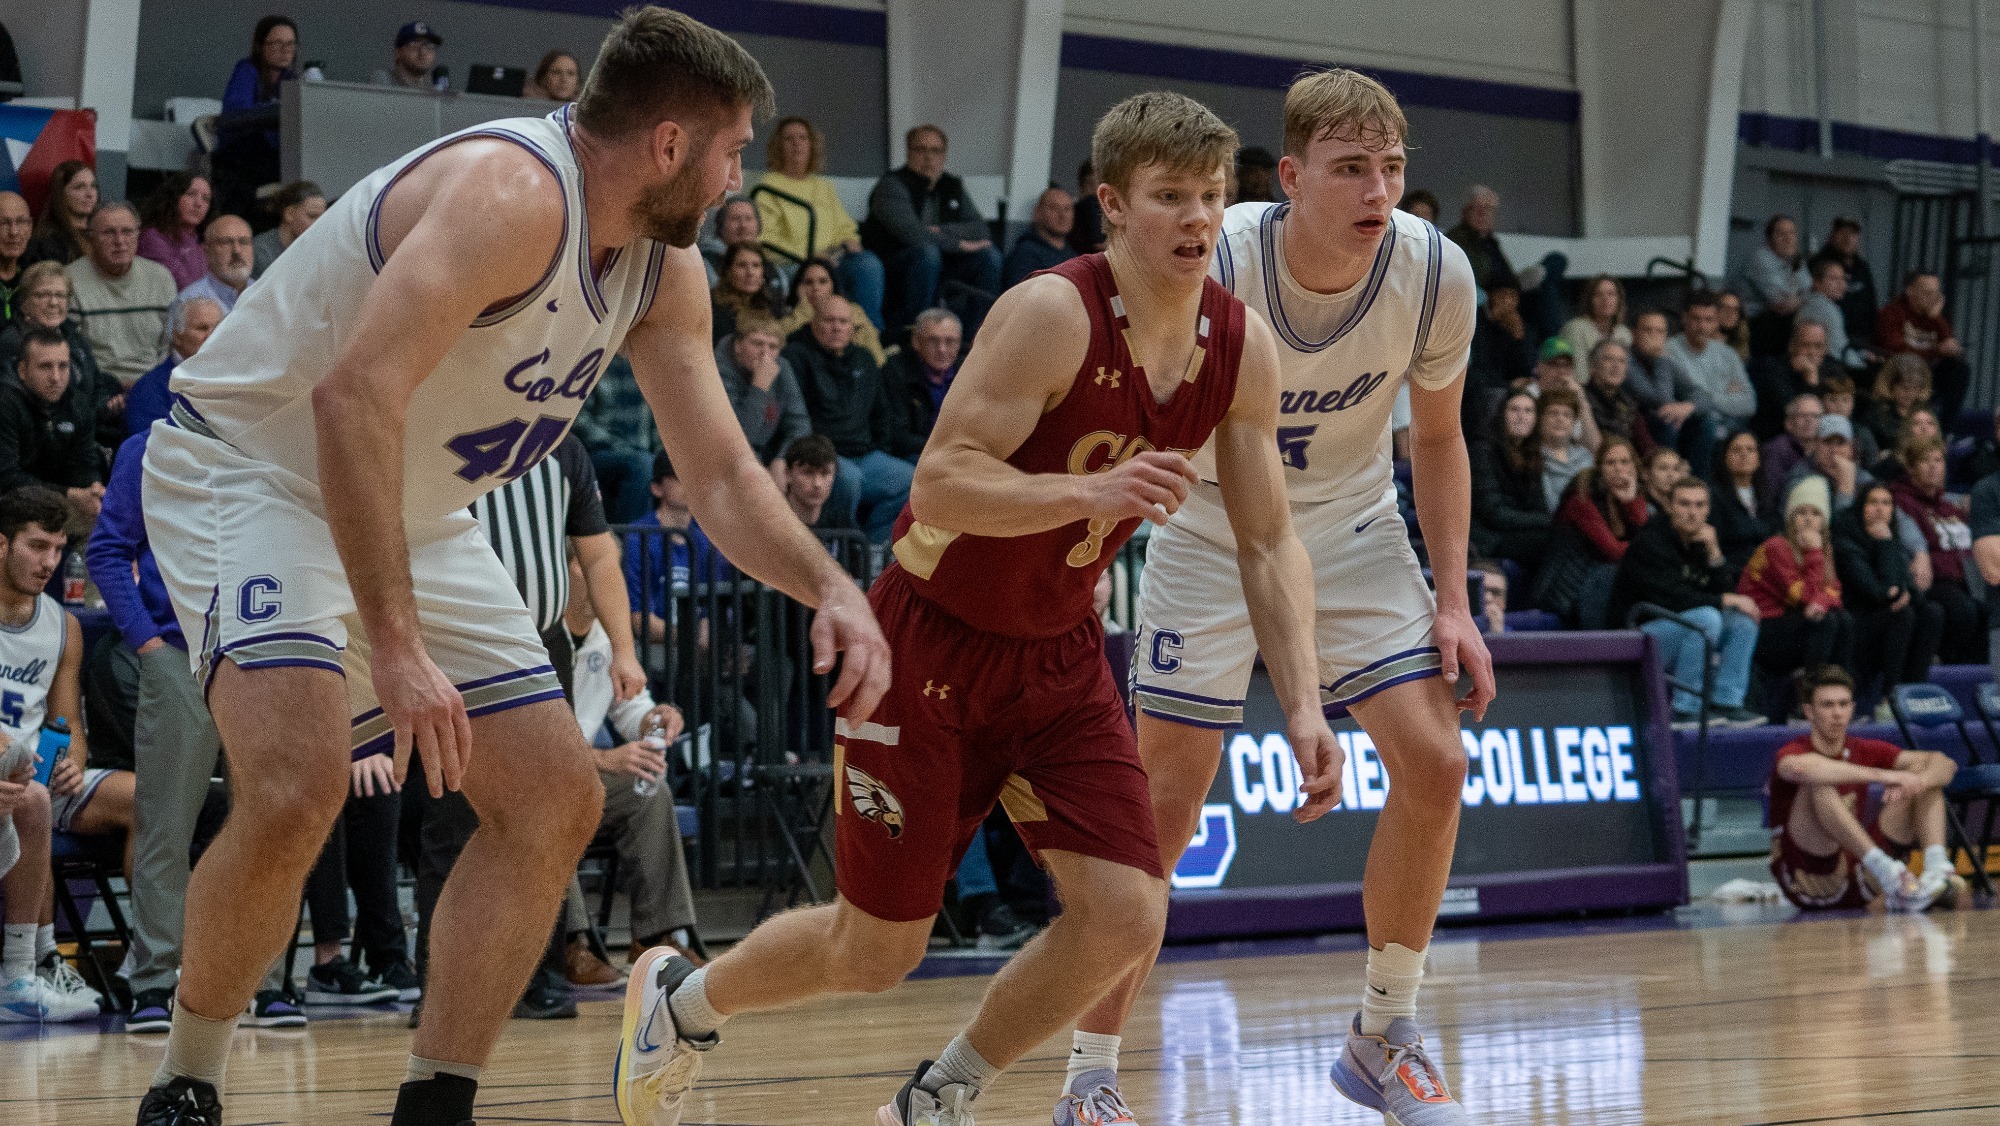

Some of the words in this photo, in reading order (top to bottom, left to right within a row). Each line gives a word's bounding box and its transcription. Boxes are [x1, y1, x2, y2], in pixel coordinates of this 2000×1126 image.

[237, 574, 282, 625] C
[1149, 628, 1185, 675] C
[1461, 725, 1642, 807] COLLEGE
